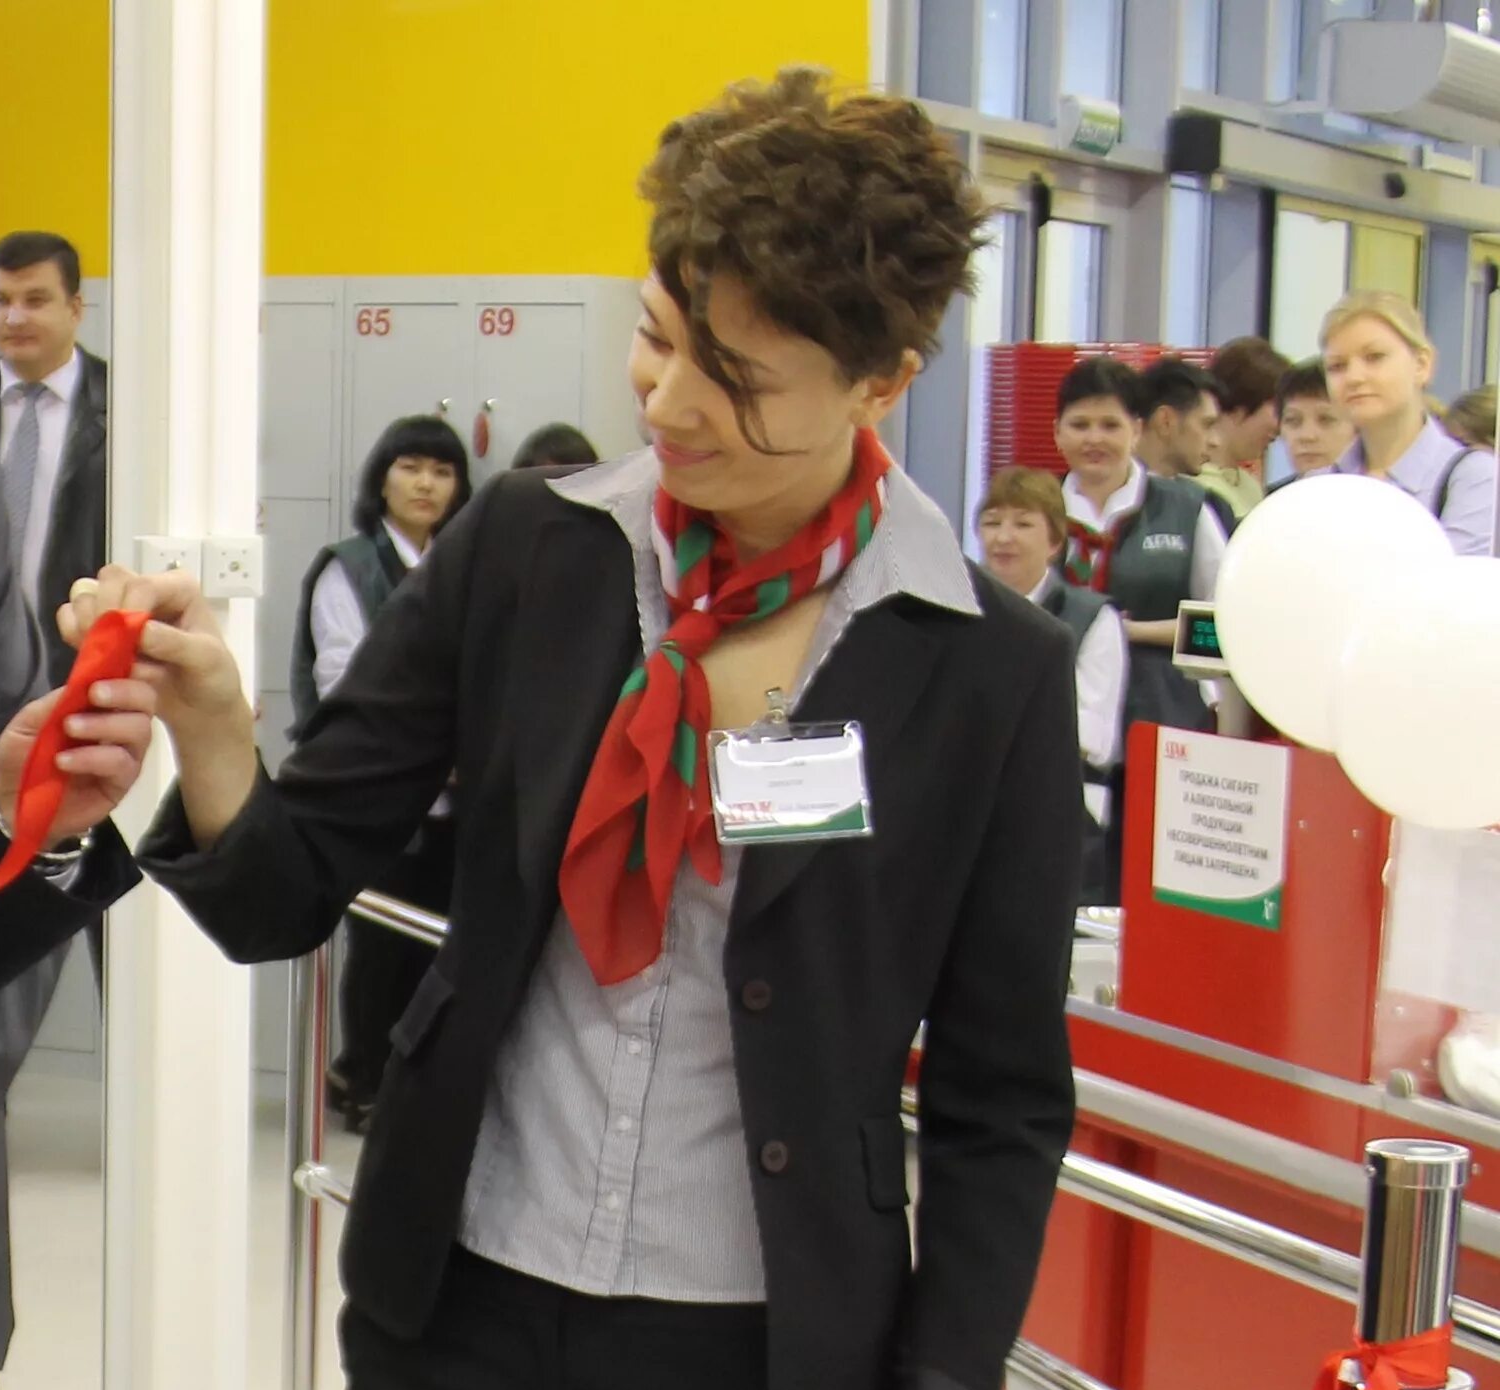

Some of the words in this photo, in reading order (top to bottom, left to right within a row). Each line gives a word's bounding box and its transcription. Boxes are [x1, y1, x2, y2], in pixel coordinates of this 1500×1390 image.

[356, 308, 390, 336] 65
[479, 307, 515, 336] 69
[1180, 769, 1219, 788] ПРОДАЖА
[1221, 777, 1260, 796] СИГАРЕТ
[1190, 792, 1254, 816] АЛКОГОЛЬНОЙ
